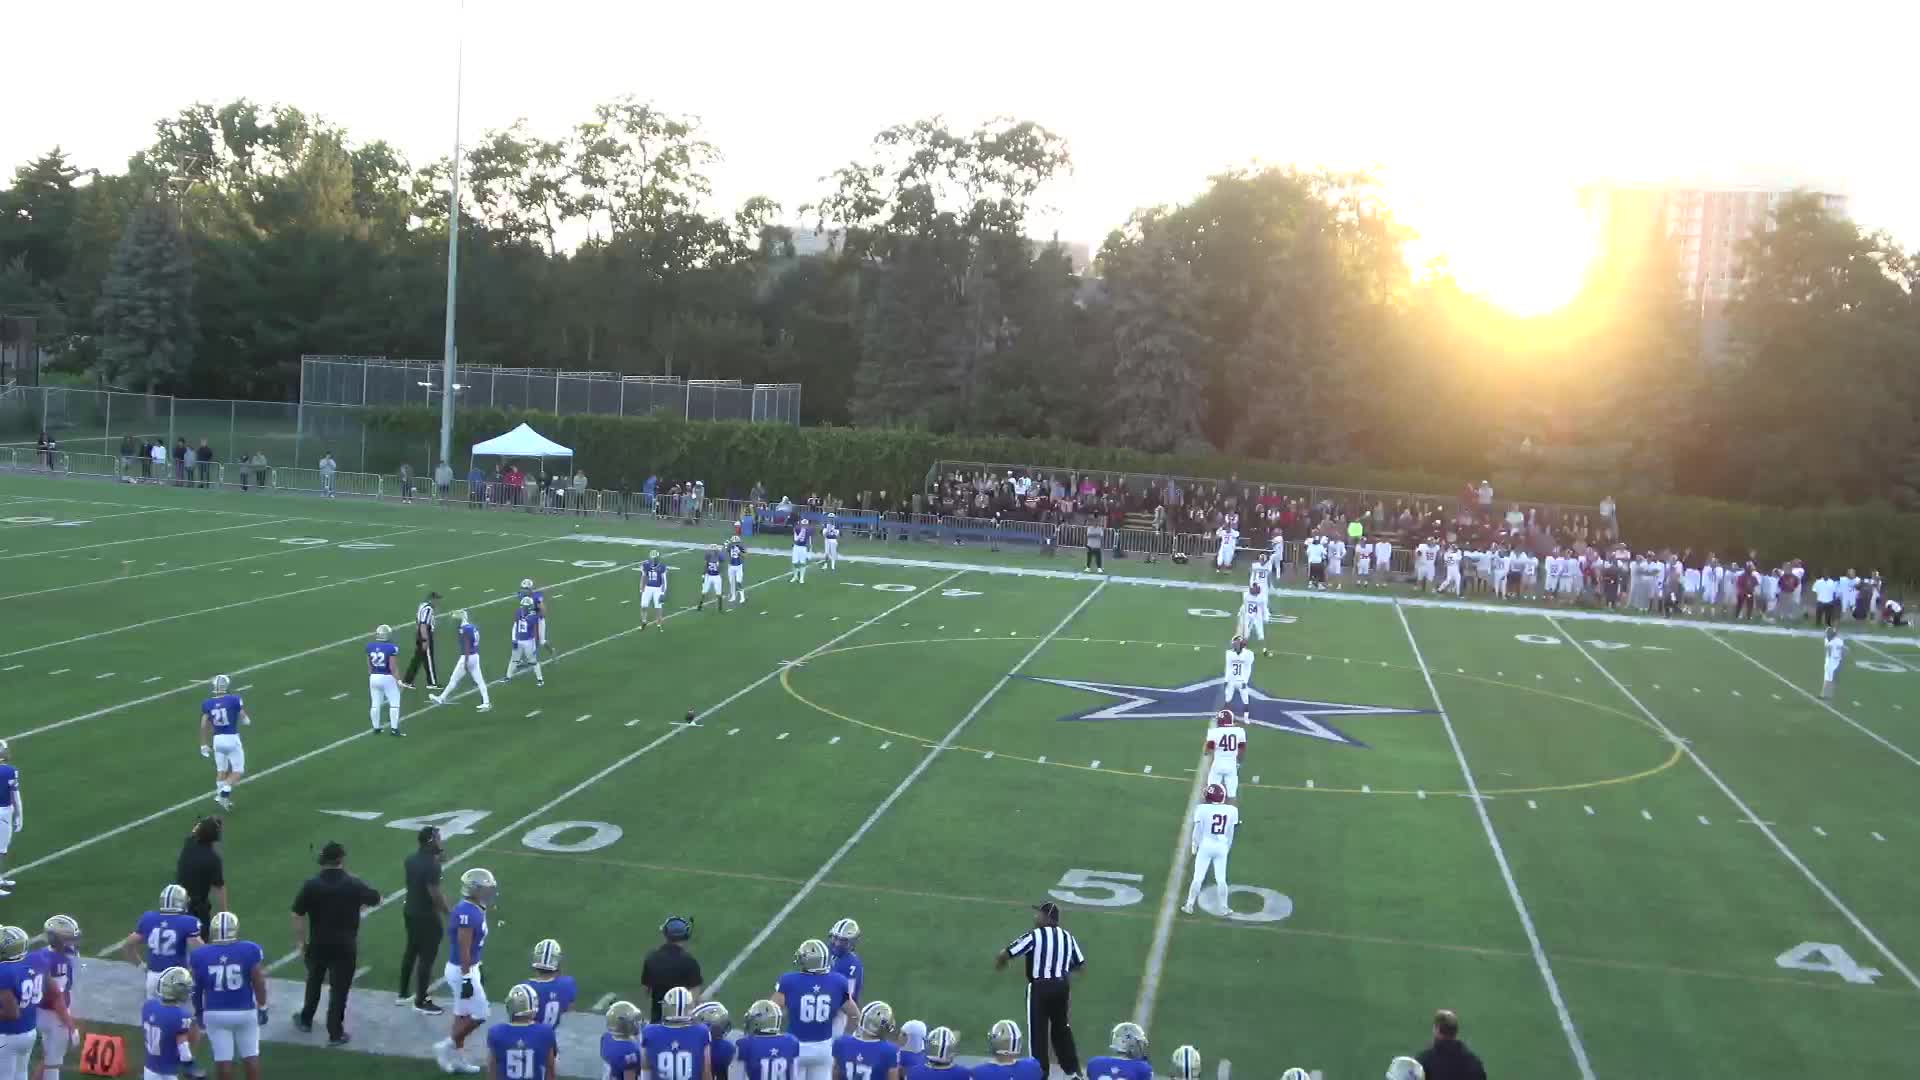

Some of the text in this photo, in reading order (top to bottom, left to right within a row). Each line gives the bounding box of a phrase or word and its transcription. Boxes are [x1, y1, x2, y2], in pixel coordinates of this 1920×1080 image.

[369, 651, 386, 667] 22
[1232, 663, 1243, 676] 31
[211, 708, 230, 727] 21
[1219, 734, 1237, 752] 40
[1211, 813, 1228, 835] 21
[148, 928, 177, 956] 42
[208, 964, 243, 991] 76
[800, 994, 832, 1023] 66
[85, 1040, 115, 1072] 40
[506, 1049, 535, 1079] 51
[657, 1051, 693, 1080] 90
